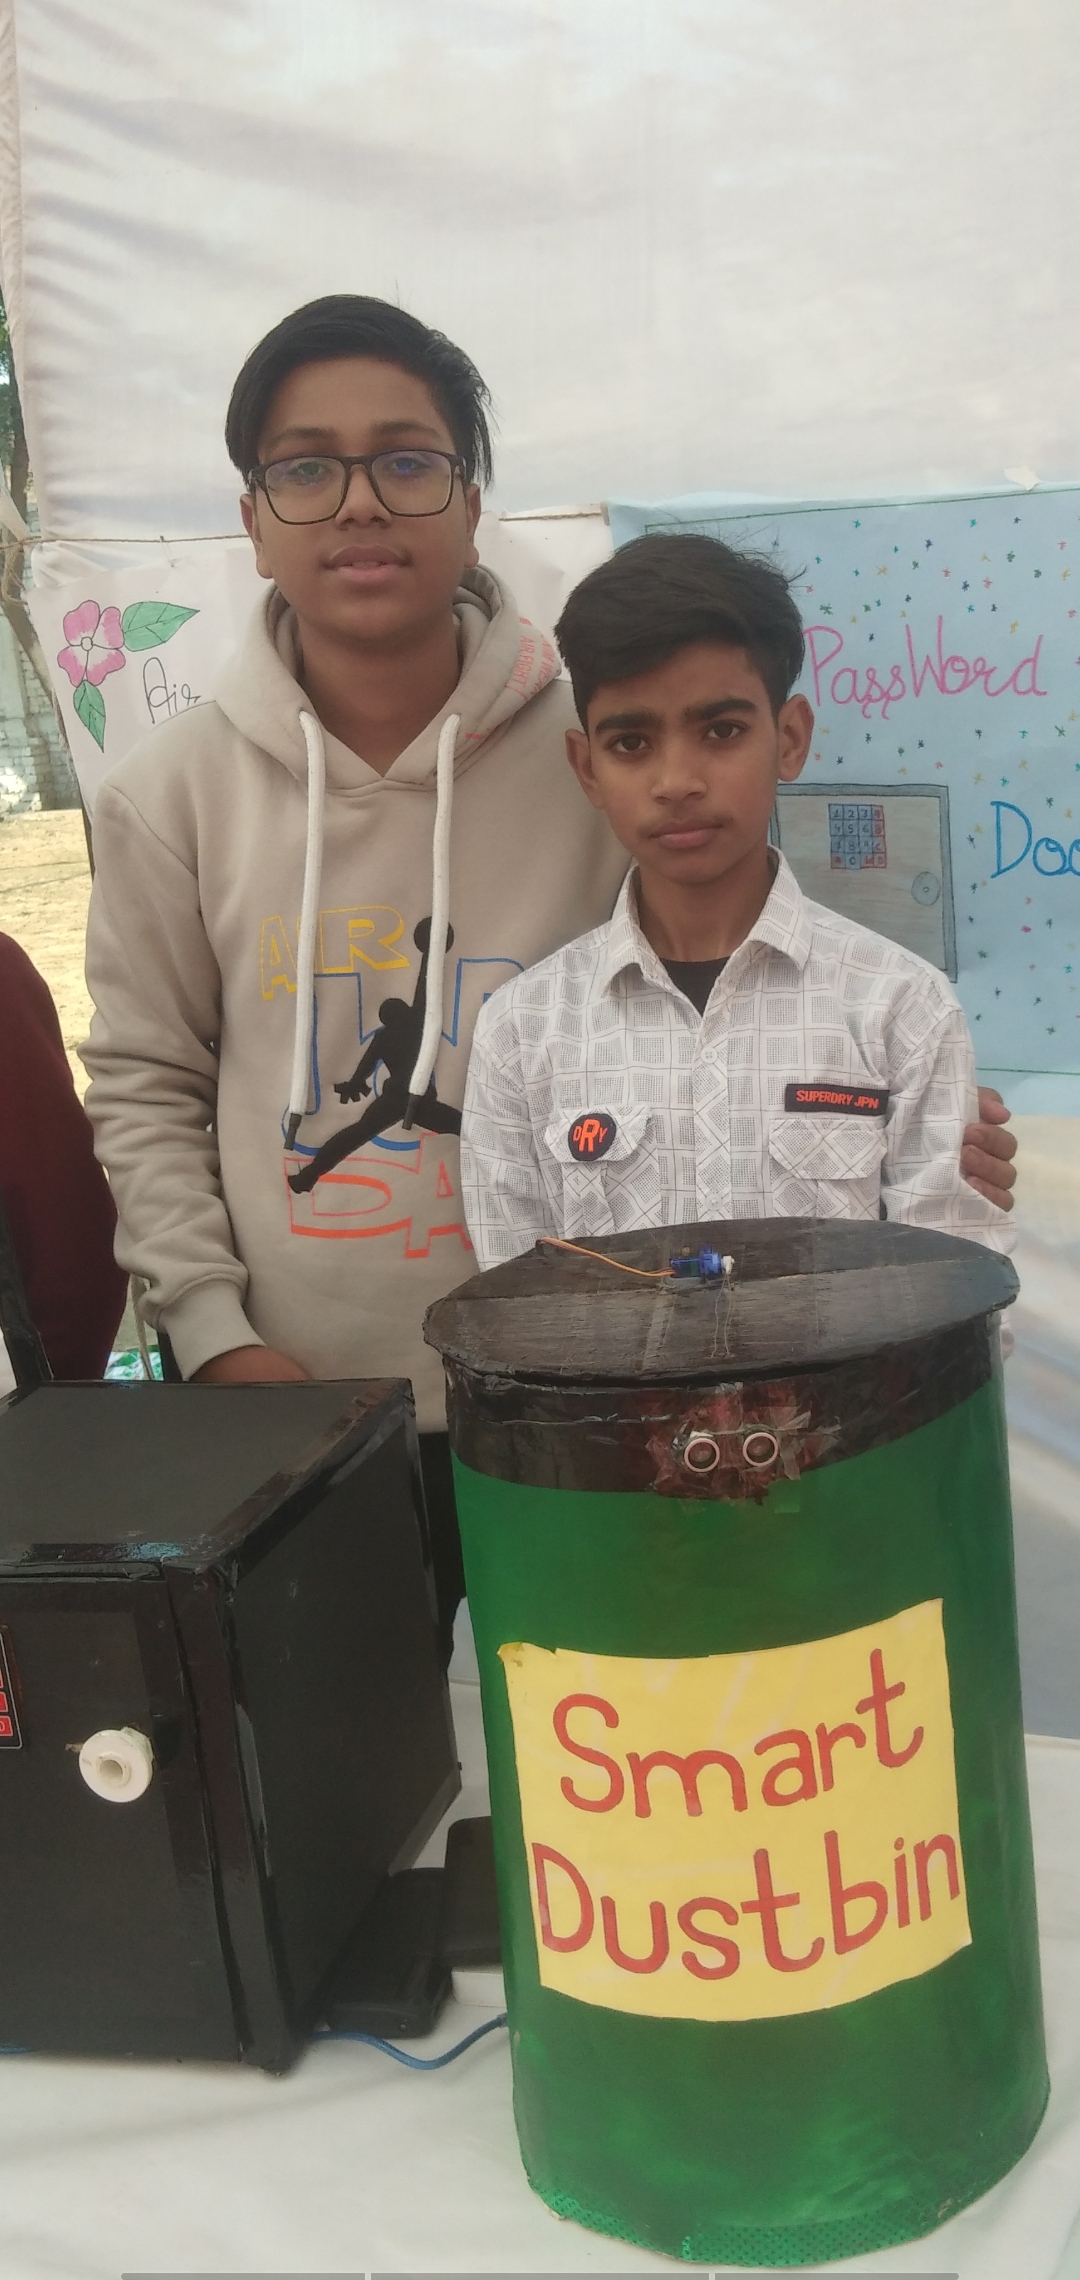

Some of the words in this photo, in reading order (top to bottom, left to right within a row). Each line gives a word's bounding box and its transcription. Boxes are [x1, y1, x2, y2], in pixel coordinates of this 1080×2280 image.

[260, 905, 411, 1000] AR
[572, 1118, 608, 1152] DRY
[796, 1089, 854, 1106] SUPERDRY
[854, 1095, 880, 1110] JPN
[552, 1647, 925, 1819] Smart
[530, 1829, 962, 1981] Dustbin
